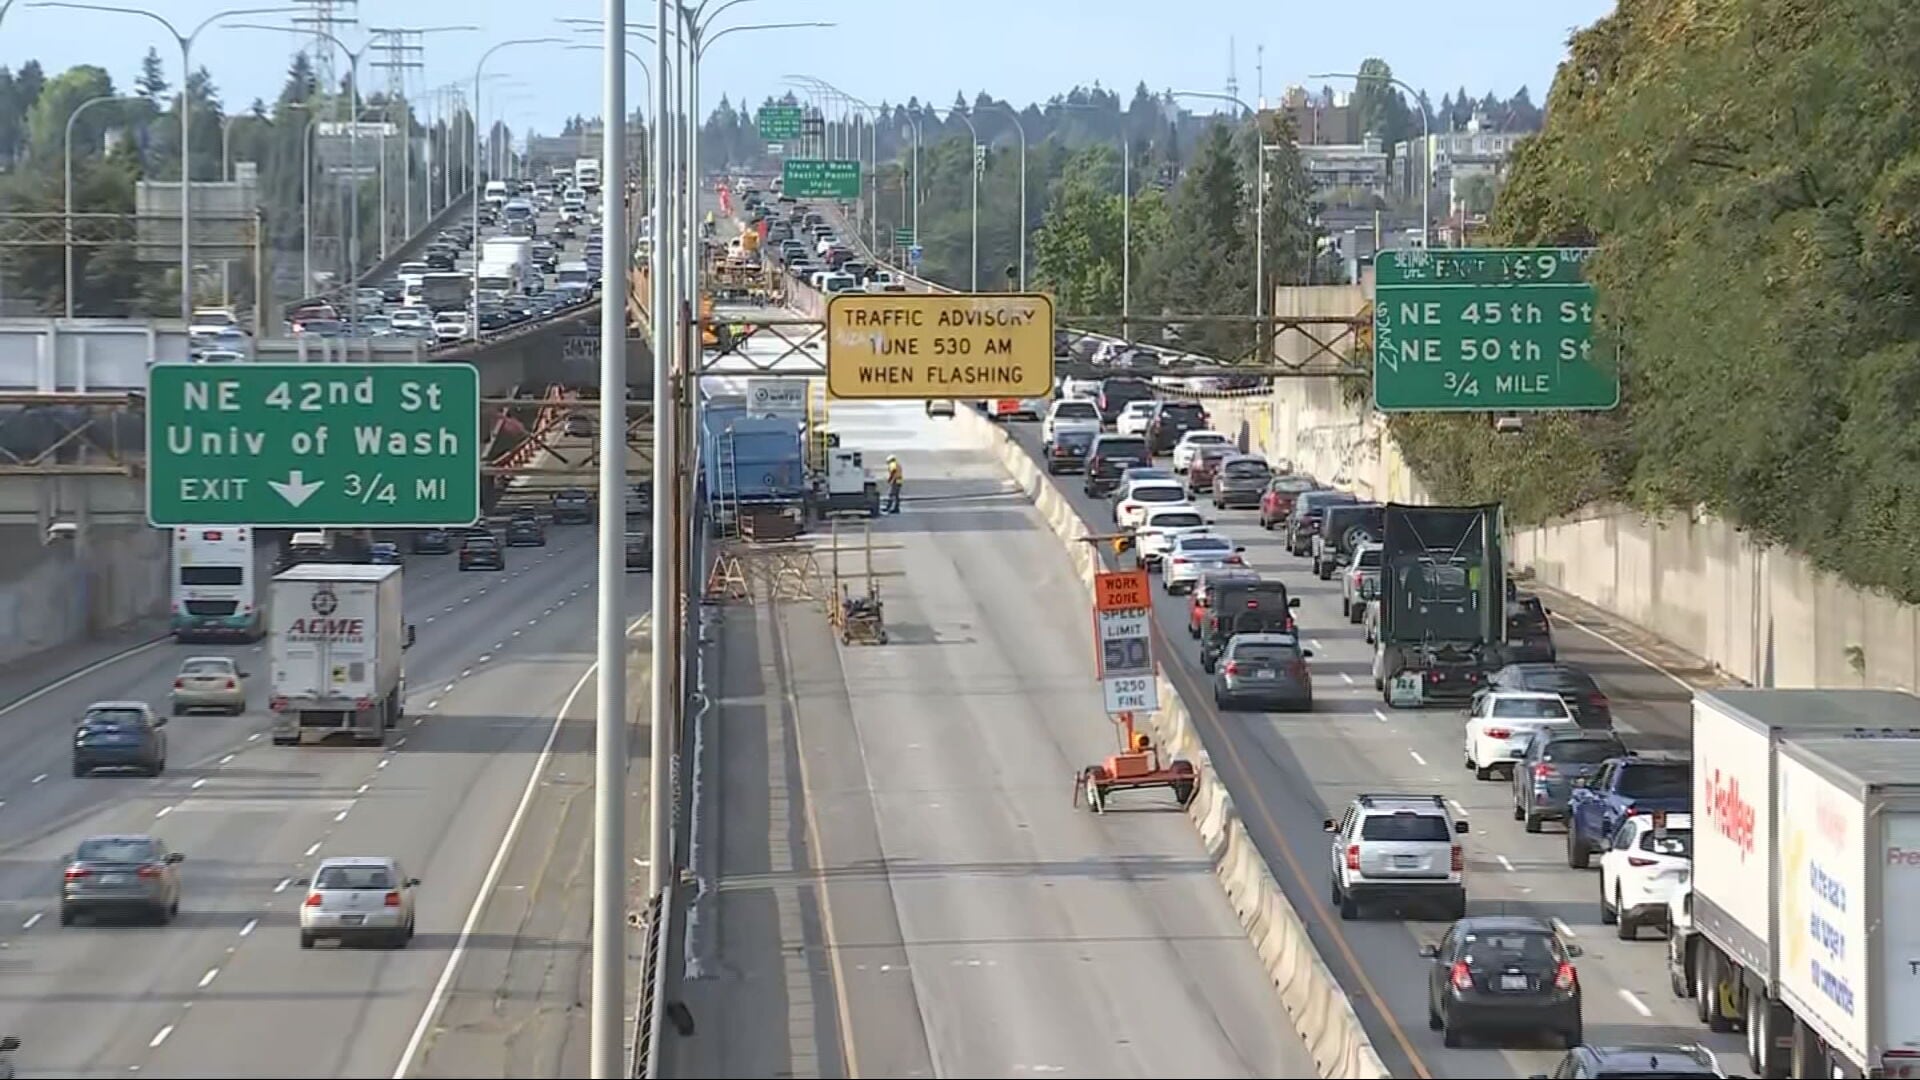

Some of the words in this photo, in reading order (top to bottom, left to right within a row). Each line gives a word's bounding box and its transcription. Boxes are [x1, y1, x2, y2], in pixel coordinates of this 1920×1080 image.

[844, 309, 923, 327] TRAFFIC
[1400, 303, 1441, 325] NE
[1460, 302, 1542, 324] 45th
[1559, 301, 1592, 323] St
[934, 338, 971, 355] 530
[984, 338, 1013, 355] AM
[1401, 340, 1442, 362] NE
[1460, 339, 1541, 361] 50th
[1559, 338, 1592, 360] St
[859, 366, 914, 384] WHEN
[927, 366, 1024, 384] FLASHING
[1443, 371, 1479, 397] 3/4
[1496, 375, 1550, 393] MILE
[184, 381, 241, 410] NE
[264, 376, 374, 410] 42nd
[400, 381, 442, 411] St
[167, 426, 265, 455] Univ
[291, 426, 329, 455] of
[354, 426, 459, 455] Wash
[180, 478, 249, 501] EXIT
[344, 473, 397, 504] 3/4
[415, 478, 446, 500] MI
[1105, 577, 1139, 590] WORK
[1108, 592, 1138, 606] ZONE
[1102, 607, 1146, 620] SPEED
[287, 618, 364, 635] ACME
[1108, 624, 1141, 637] LIMIT
[1117, 696, 1145, 707] FINE
